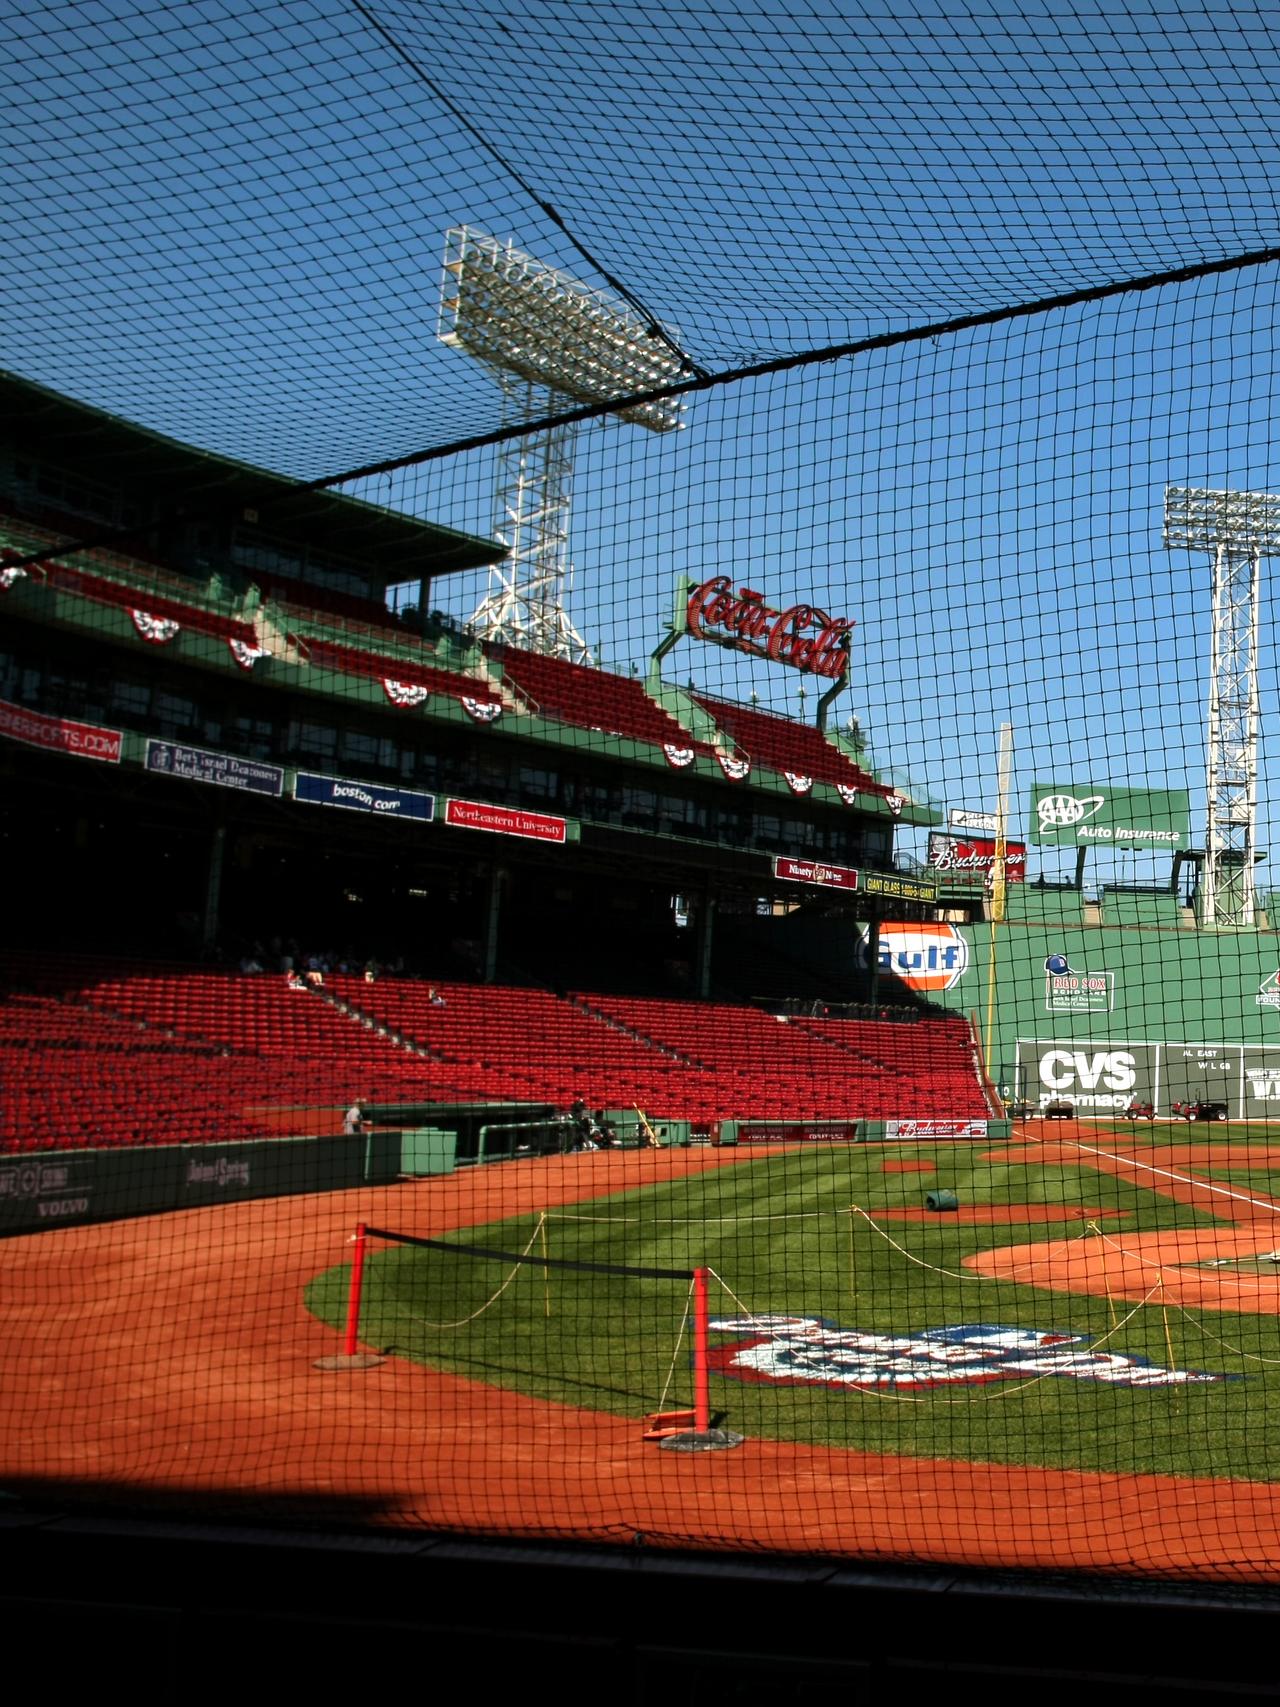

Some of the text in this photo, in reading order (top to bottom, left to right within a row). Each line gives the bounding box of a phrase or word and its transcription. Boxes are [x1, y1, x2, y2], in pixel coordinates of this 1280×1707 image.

[688, 575, 857, 678] Coca-Cola
[332, 783, 401, 810] bostoncom
[1041, 796, 1081, 824] AAA
[453, 806, 561, 838] Northeastern University
[1077, 825, 1180, 841] Auto Insurance
[788, 863, 813, 878] Ninety
[1054, 976, 1107, 991] RED SOX
[1039, 1049, 1137, 1091] CVS
[1039, 1091, 1134, 1109] pharmacy
